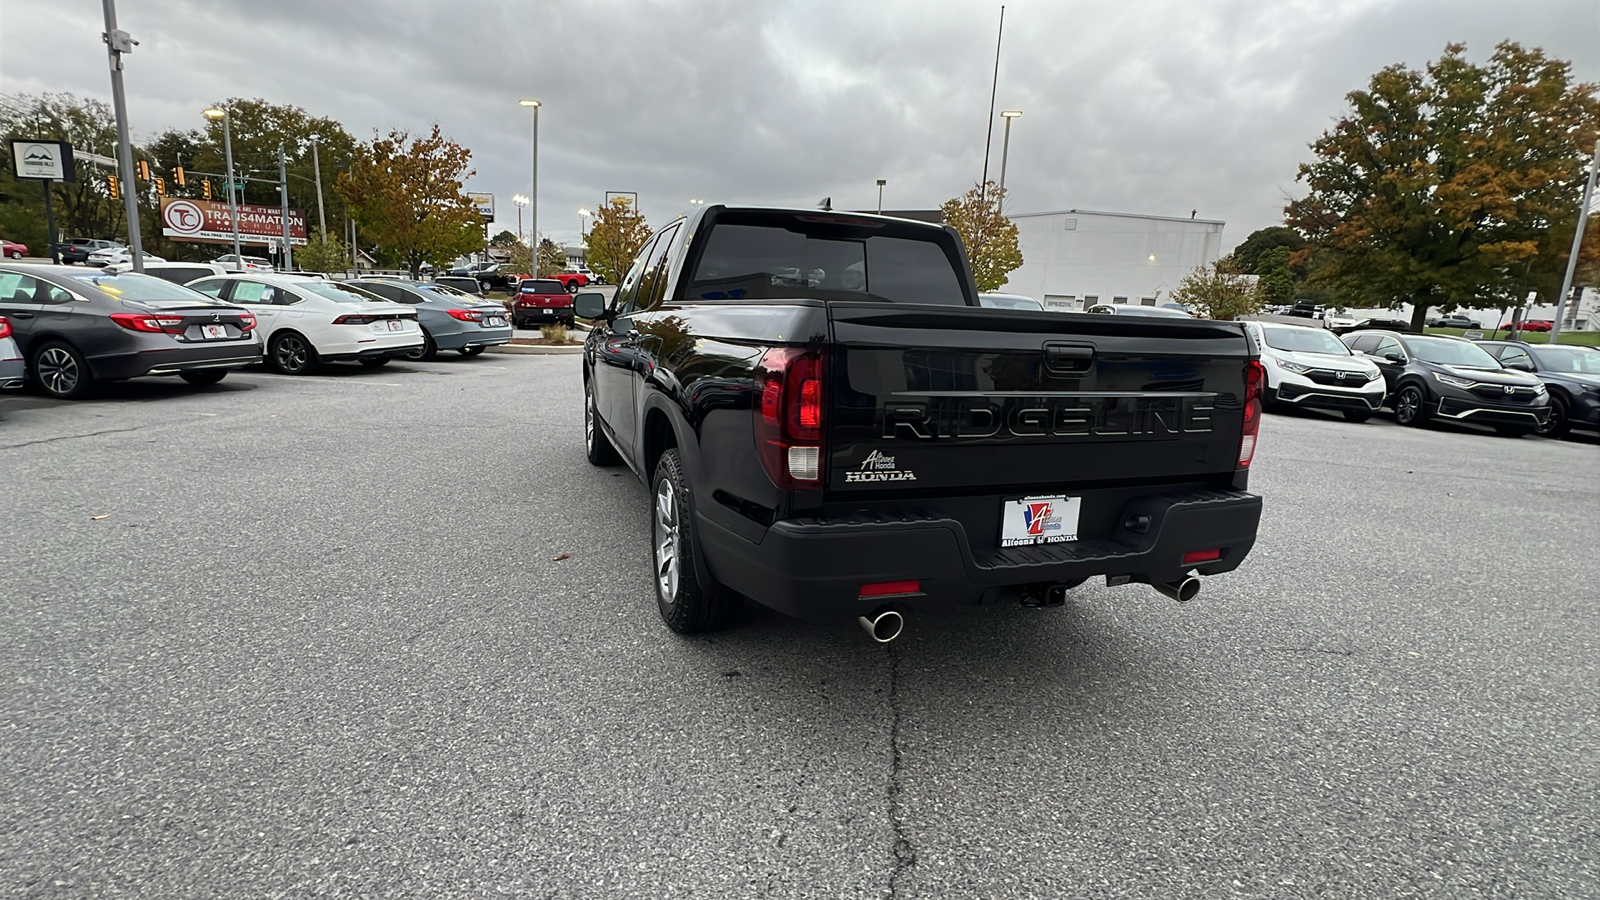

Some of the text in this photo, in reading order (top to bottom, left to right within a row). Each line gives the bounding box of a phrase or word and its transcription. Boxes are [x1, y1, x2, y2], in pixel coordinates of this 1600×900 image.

[882, 401, 1215, 439] RIDGELINE
[874, 462, 896, 470] Honda
[845, 470, 917, 482] HONDA
[1001, 538, 1035, 548] Altoona
[1046, 534, 1079, 543] HONDA
